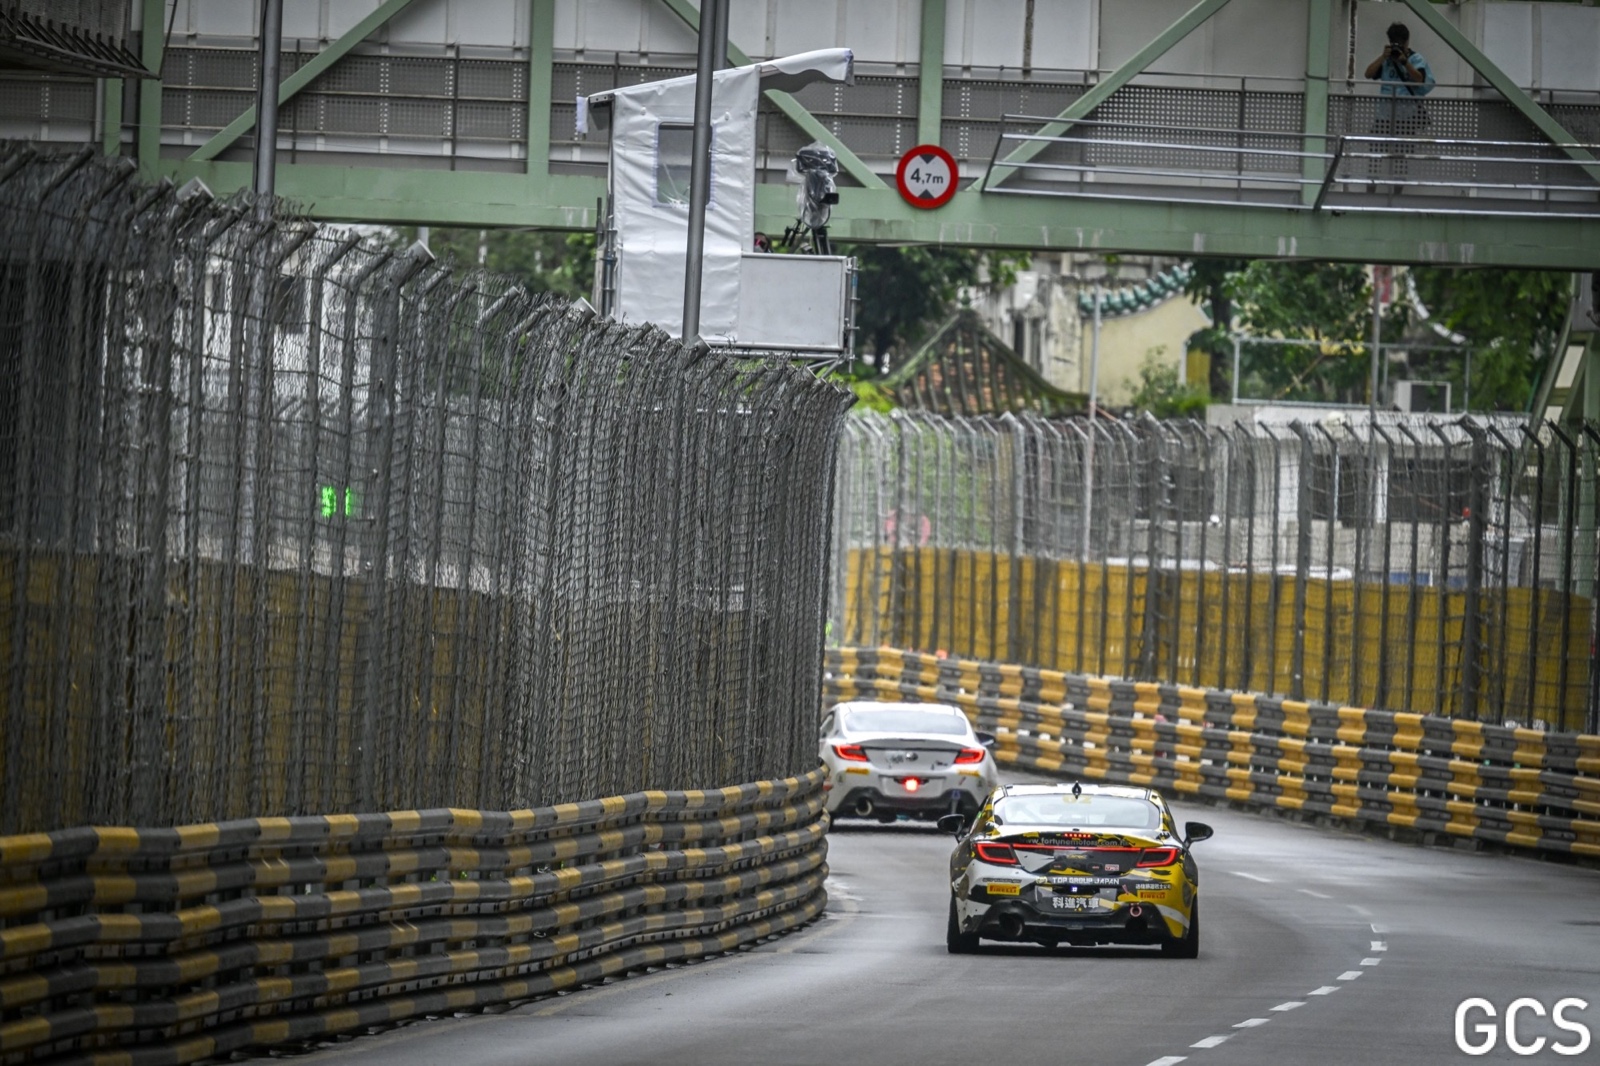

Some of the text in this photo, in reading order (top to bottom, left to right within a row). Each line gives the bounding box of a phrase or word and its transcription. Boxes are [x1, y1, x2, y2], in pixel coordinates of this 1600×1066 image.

[910, 167, 944, 185] 4,7m
[1052, 876, 1120, 885] TOP GROUP JAPAN
[1052, 896, 1099, 909] 科進汽車
